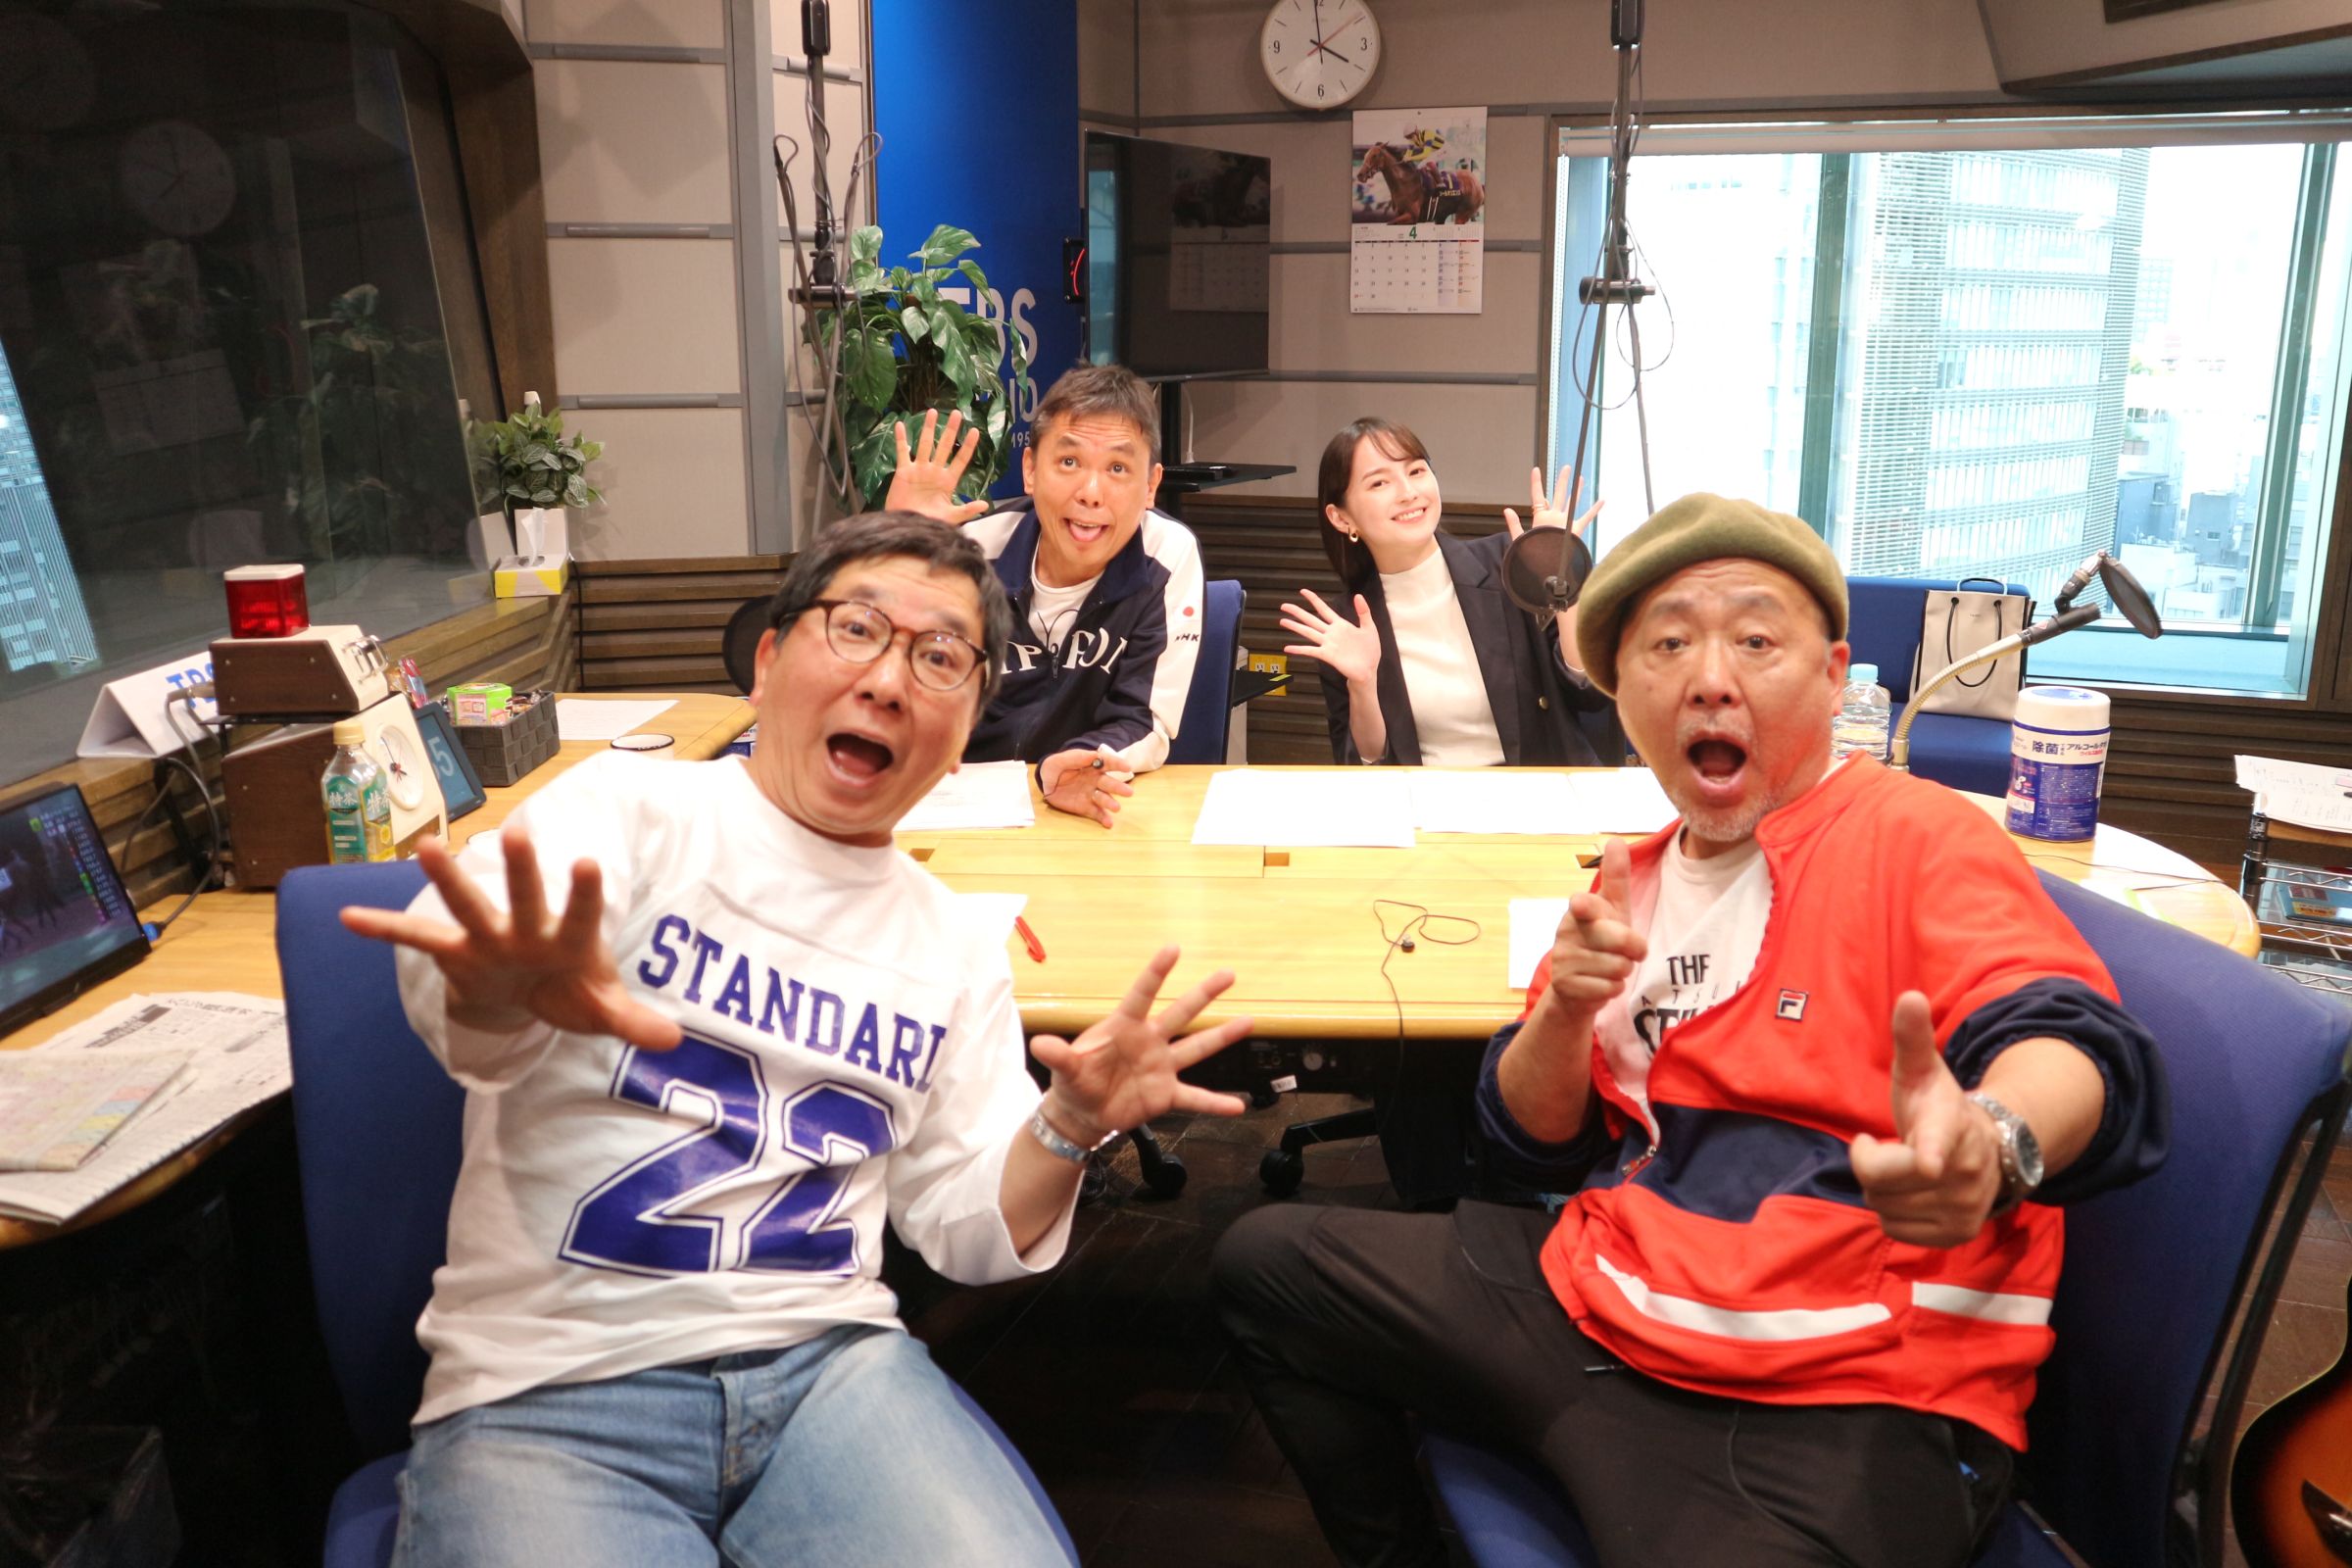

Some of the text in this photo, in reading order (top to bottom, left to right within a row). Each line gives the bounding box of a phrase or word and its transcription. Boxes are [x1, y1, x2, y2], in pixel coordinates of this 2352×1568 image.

[1273, 40, 1281, 54] 9
[1360, 37, 1368, 51] 3
[1317, 83, 1325, 98] 6
[1408, 226, 1417, 239] 4
[557, 1025, 899, 1279] 22
